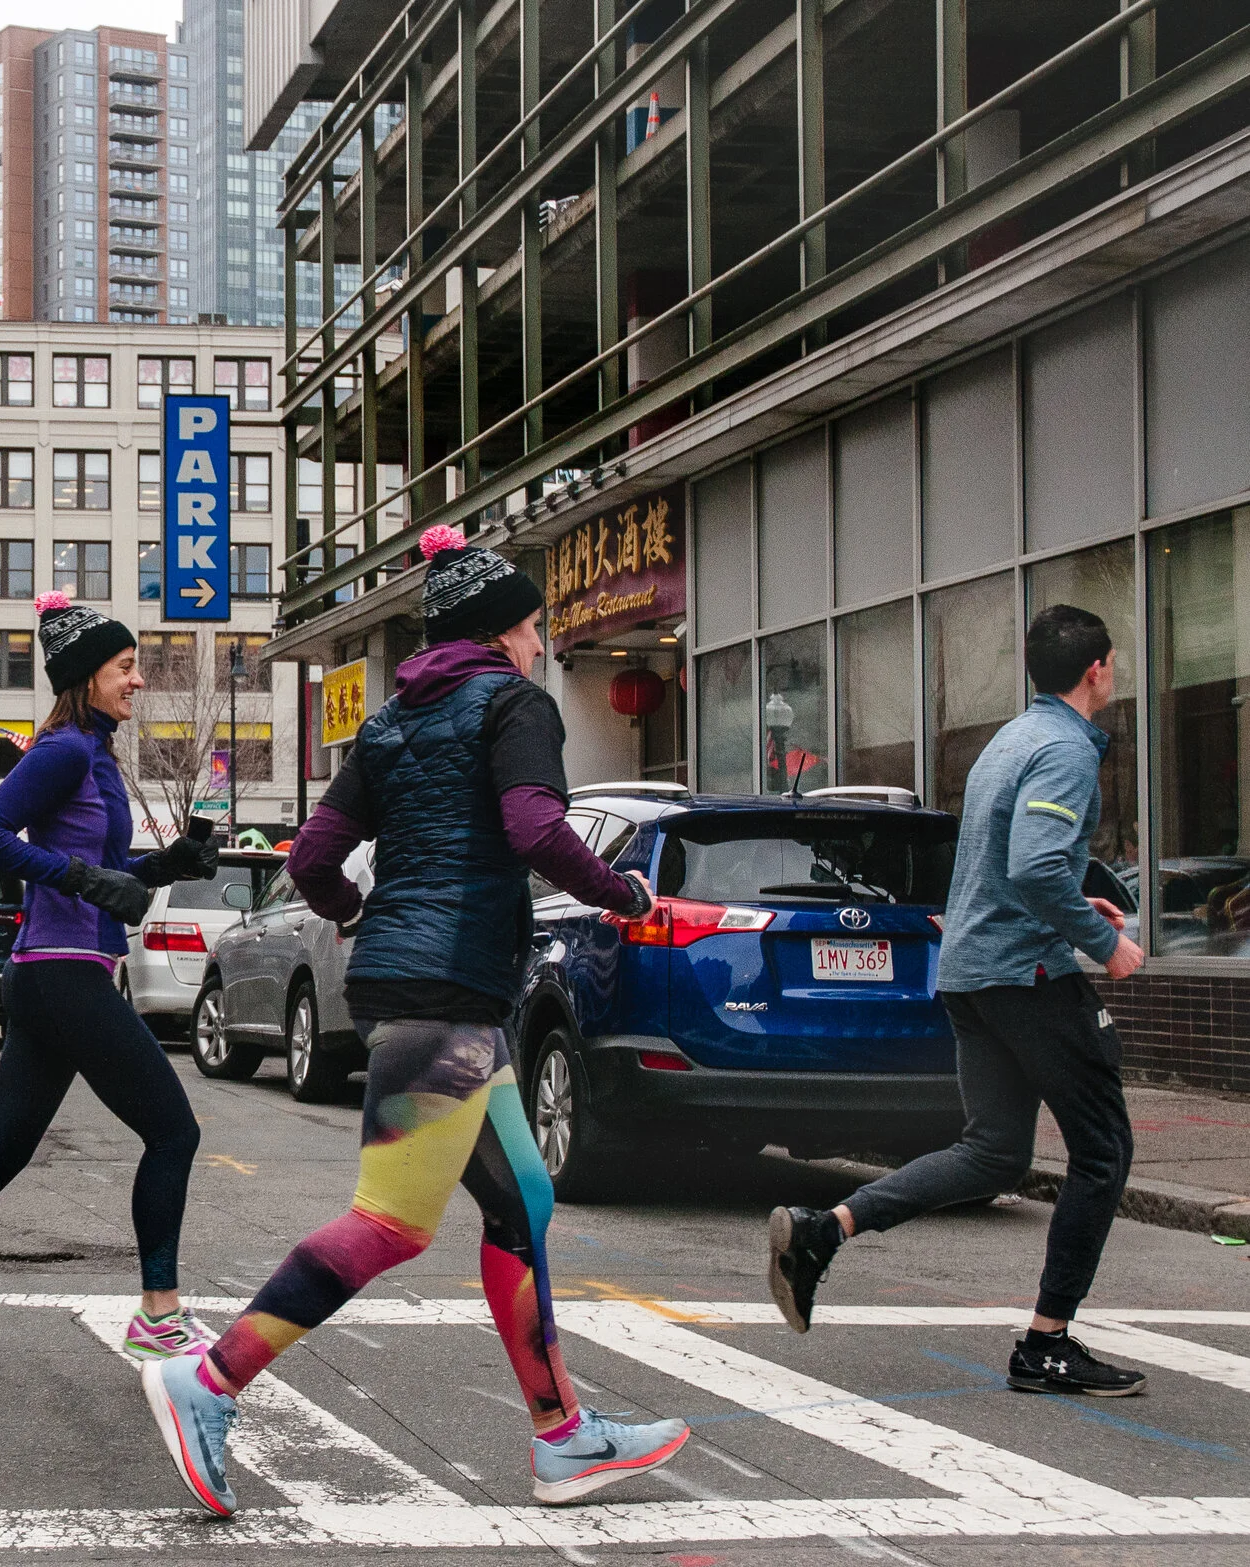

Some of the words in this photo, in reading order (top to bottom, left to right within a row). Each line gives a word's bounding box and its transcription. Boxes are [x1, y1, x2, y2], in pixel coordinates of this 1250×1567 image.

[176, 407, 217, 568] PARK
[596, 584, 657, 619] Restaurant
[817, 950, 848, 970] 1MV
[855, 950, 887, 970] 369
